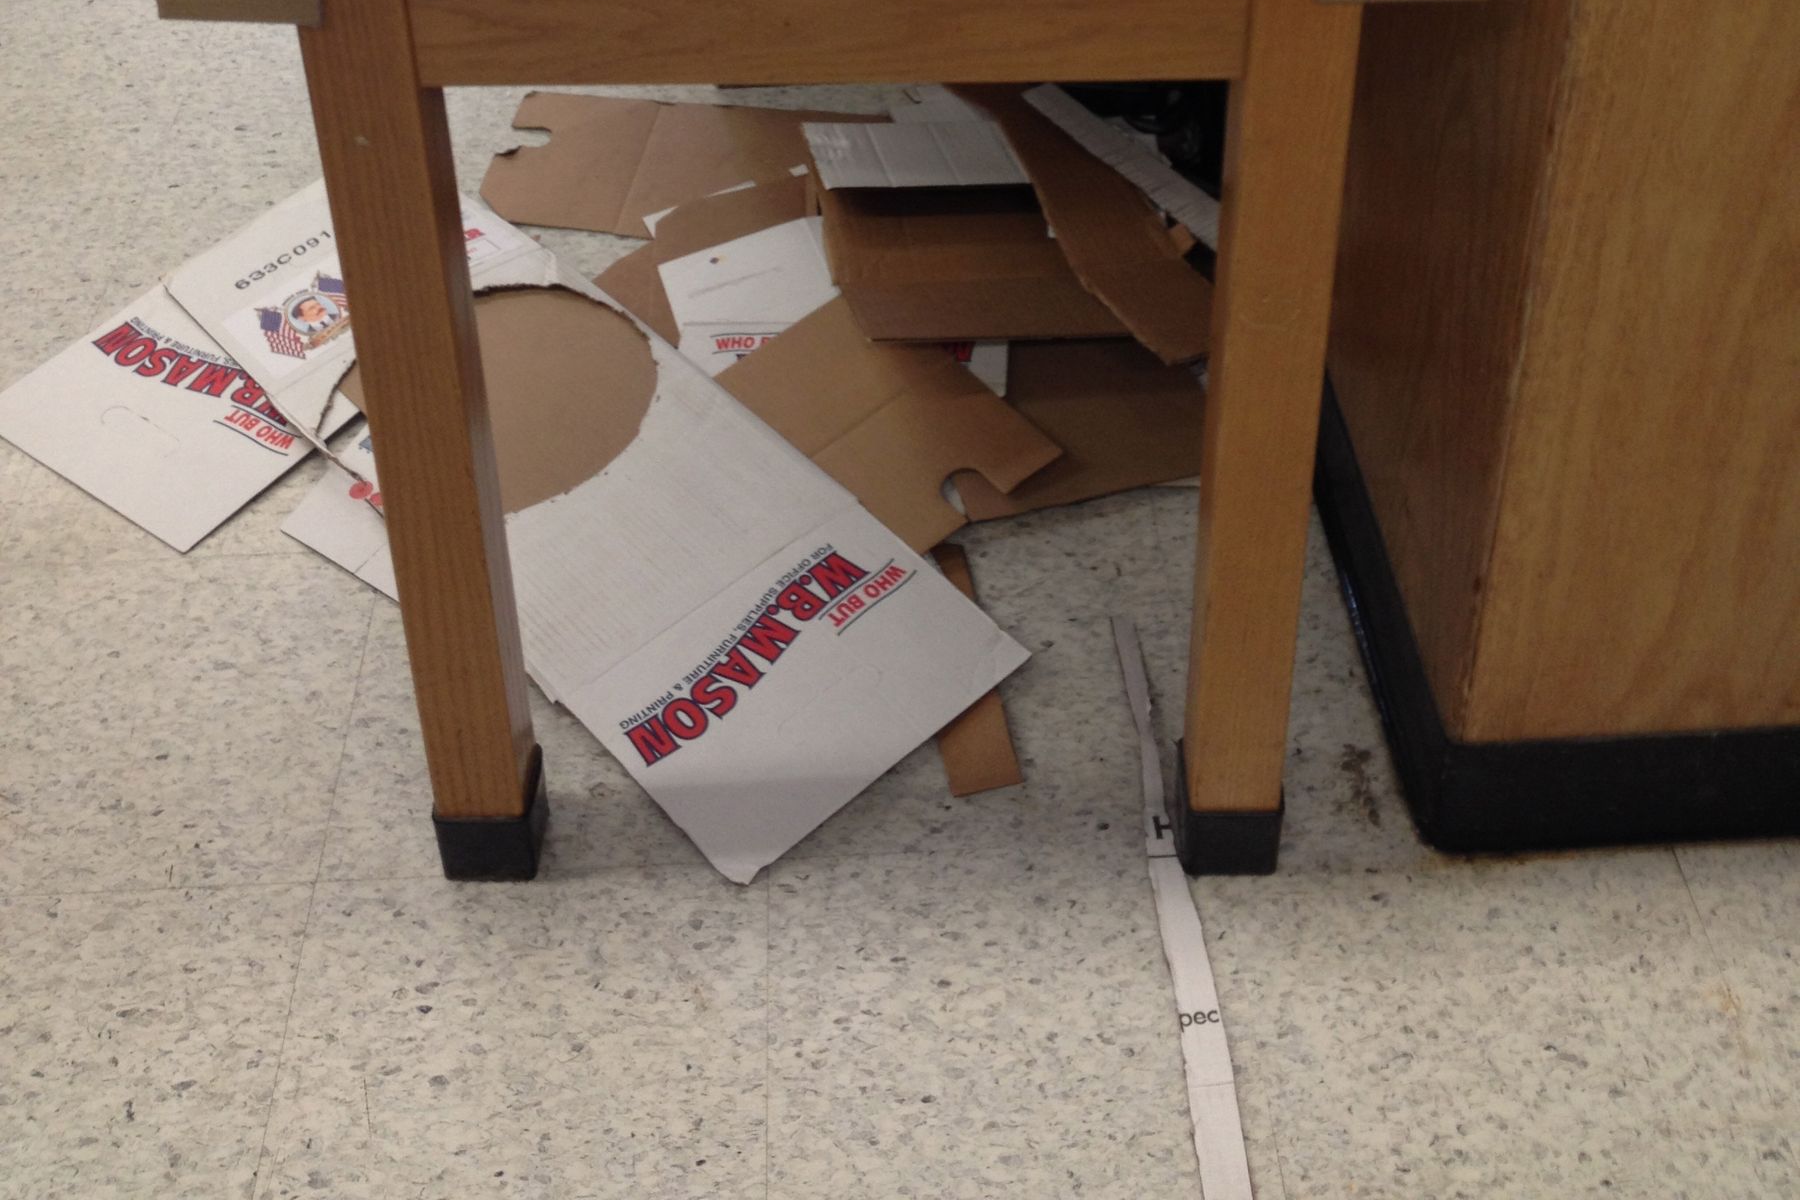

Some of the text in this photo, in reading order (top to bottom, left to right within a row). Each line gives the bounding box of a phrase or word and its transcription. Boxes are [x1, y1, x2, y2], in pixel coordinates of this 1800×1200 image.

[234, 230, 332, 290] 633C091
[715, 336, 755, 350] WHO
[224, 409, 295, 450] WHO BUT
[811, 542, 834, 561] FOR
[777, 556, 812, 588] OFFICE
[828, 564, 907, 628] WHO BUT
[682, 633, 738, 686] FURNITURE
[674, 681, 684, 692] &
[618, 690, 674, 730] PRINTING
[1179, 1009, 1220, 1033] pec
